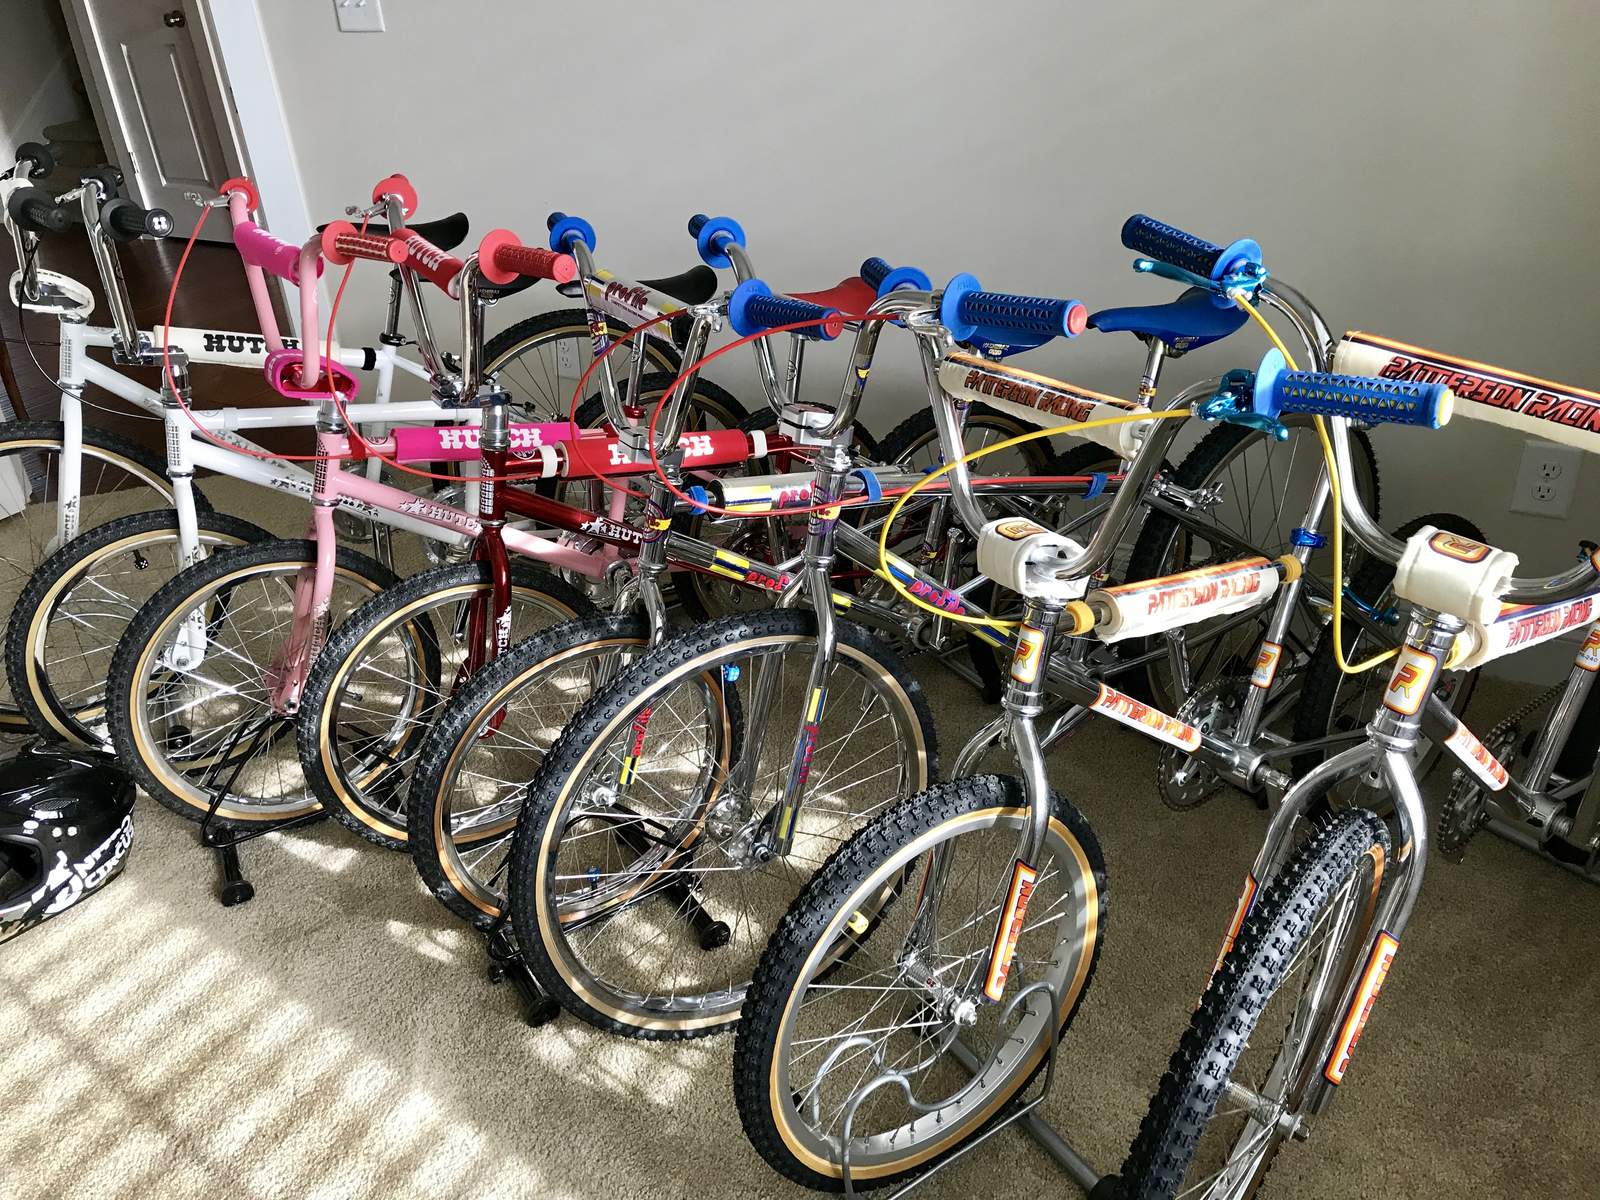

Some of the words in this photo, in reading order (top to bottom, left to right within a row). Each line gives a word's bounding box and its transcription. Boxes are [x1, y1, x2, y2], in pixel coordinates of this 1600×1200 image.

[405, 235, 450, 272] HUTCH
[605, 281, 651, 311] profile
[203, 333, 300, 354] HUTH
[964, 369, 1042, 410] PATTERSON
[1037, 392, 1096, 423] RACING
[1378, 356, 1533, 414] PATTERSON
[438, 428, 543, 450] HUCH
